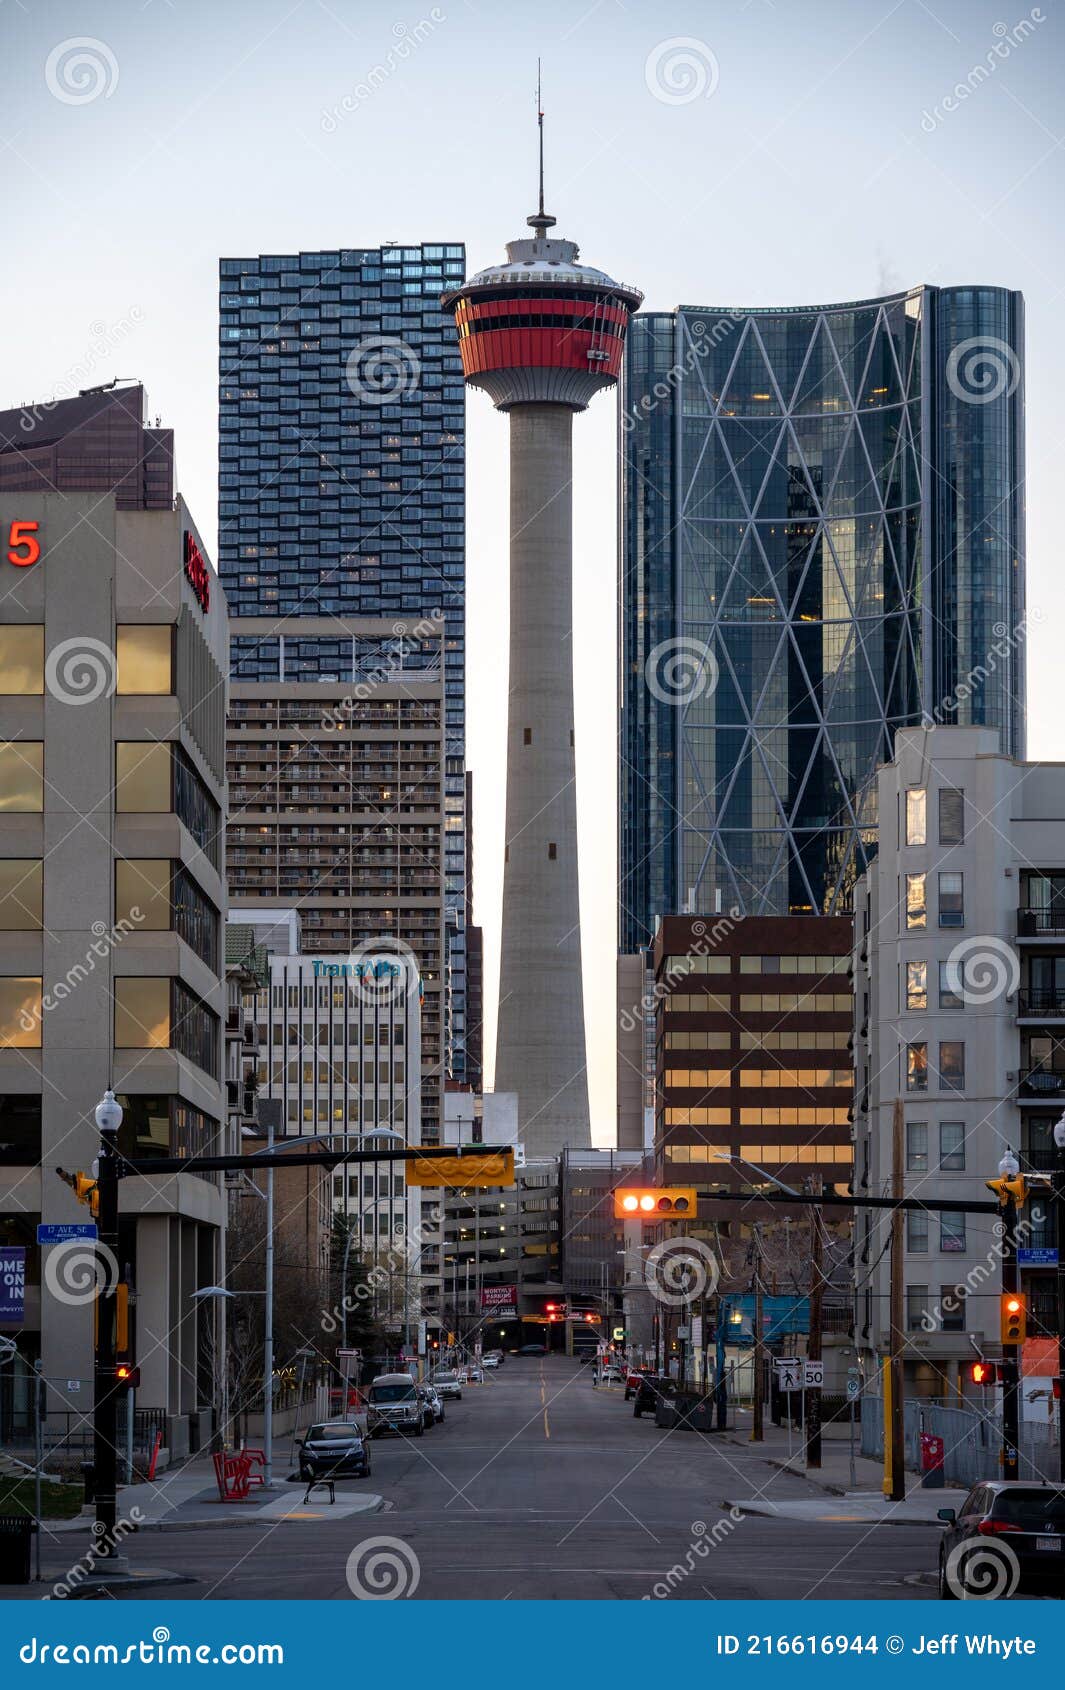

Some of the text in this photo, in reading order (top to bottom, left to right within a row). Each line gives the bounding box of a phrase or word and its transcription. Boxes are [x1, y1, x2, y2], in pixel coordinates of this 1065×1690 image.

[8, 520, 41, 567] 5
[4, 1273, 25, 1286] ON
[9, 1286, 25, 1299] IN
[806, 1372, 823, 1383] 50
